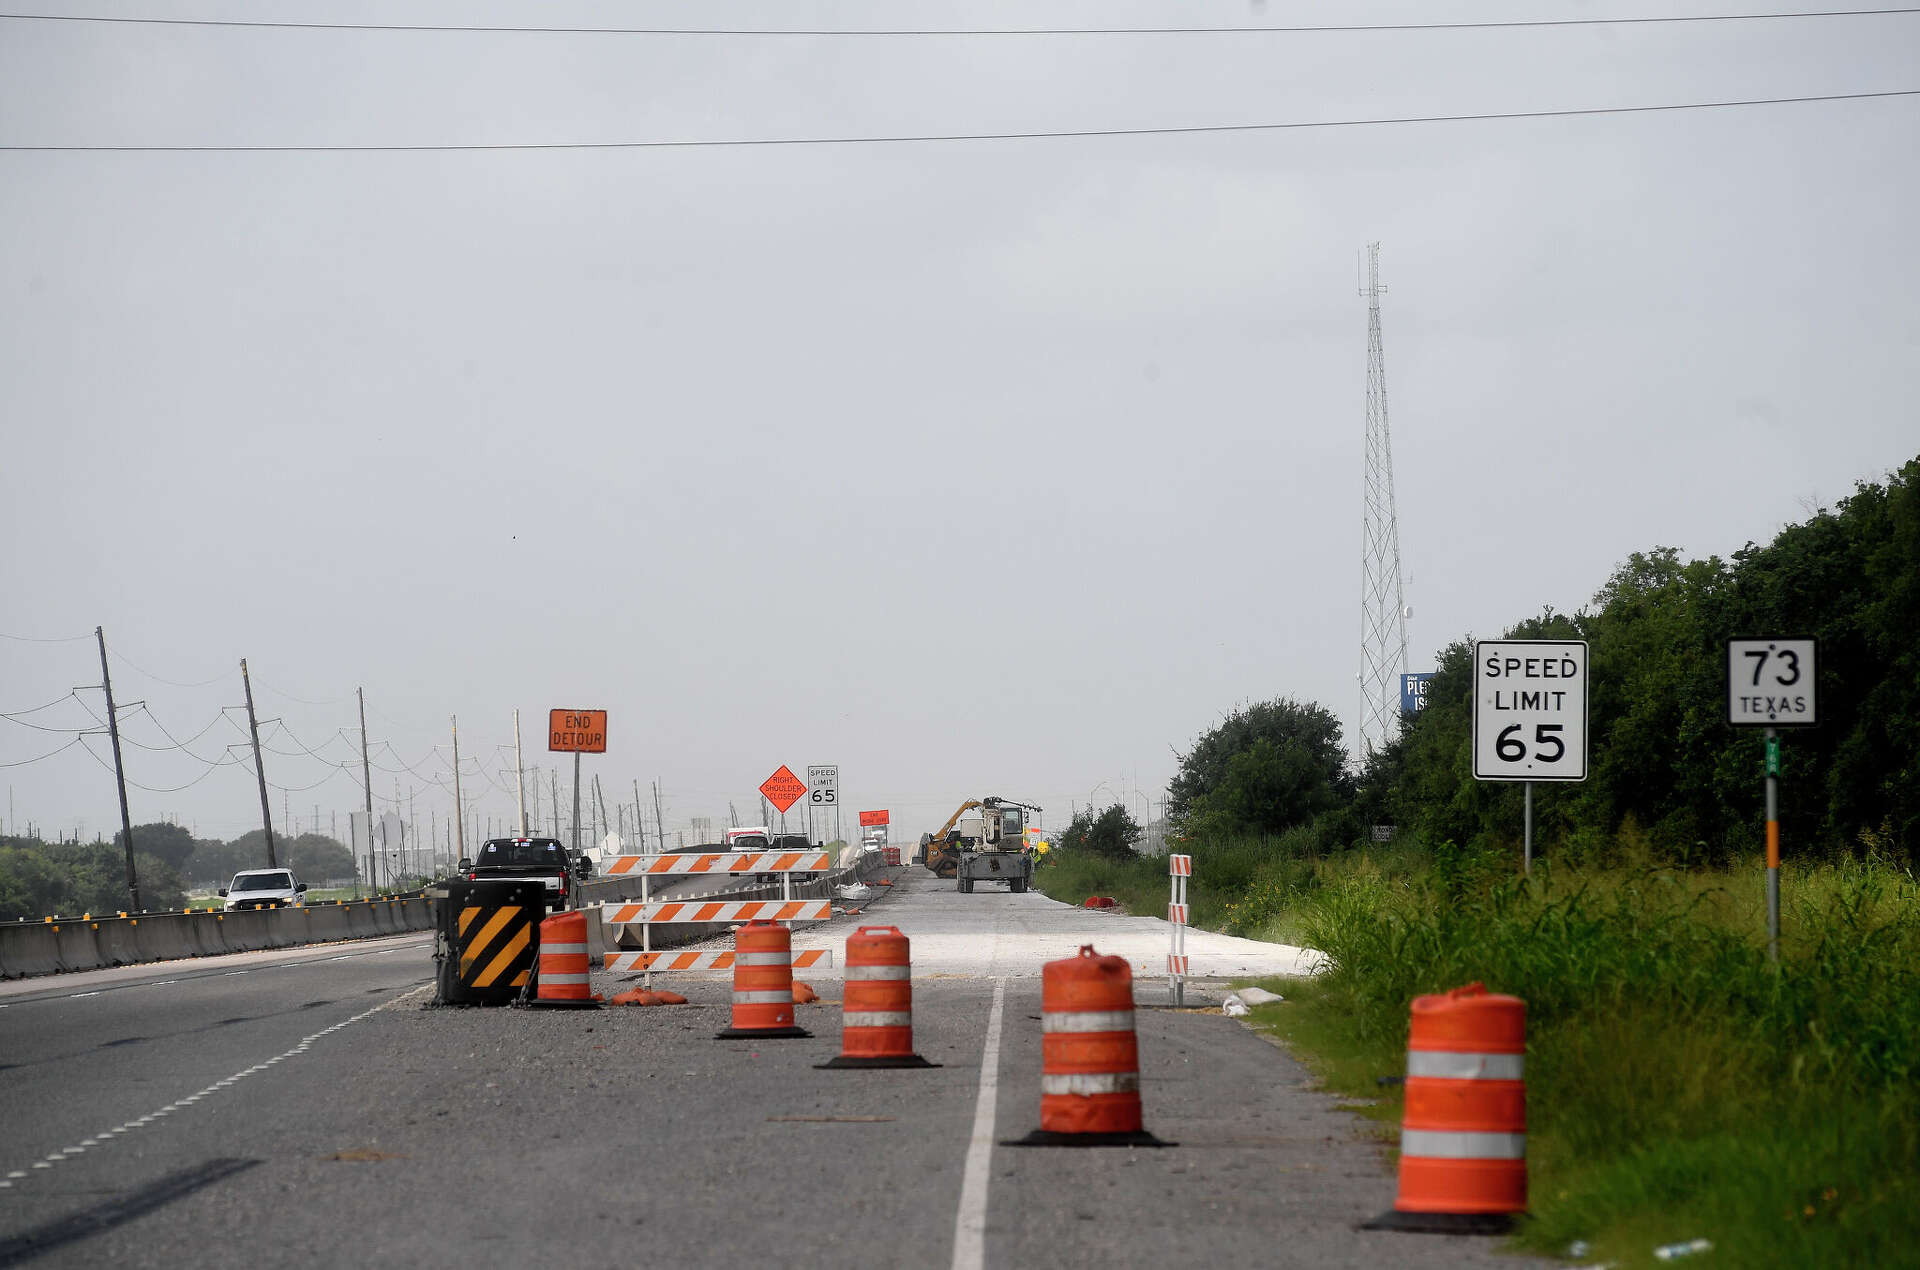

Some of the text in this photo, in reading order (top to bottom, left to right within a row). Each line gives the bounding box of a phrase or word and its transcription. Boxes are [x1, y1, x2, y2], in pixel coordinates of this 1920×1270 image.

[1486, 658, 1577, 678] SPEED
[1744, 650, 1800, 686] 73
[1495, 691, 1566, 711] LIMIT
[1740, 696, 1806, 713] TEXAS
[566, 716, 591, 728] END
[553, 732, 602, 745] DETOUR
[1496, 724, 1565, 762] 65
[765, 785, 802, 793] SHOULDER
[812, 789, 835, 802] 65
